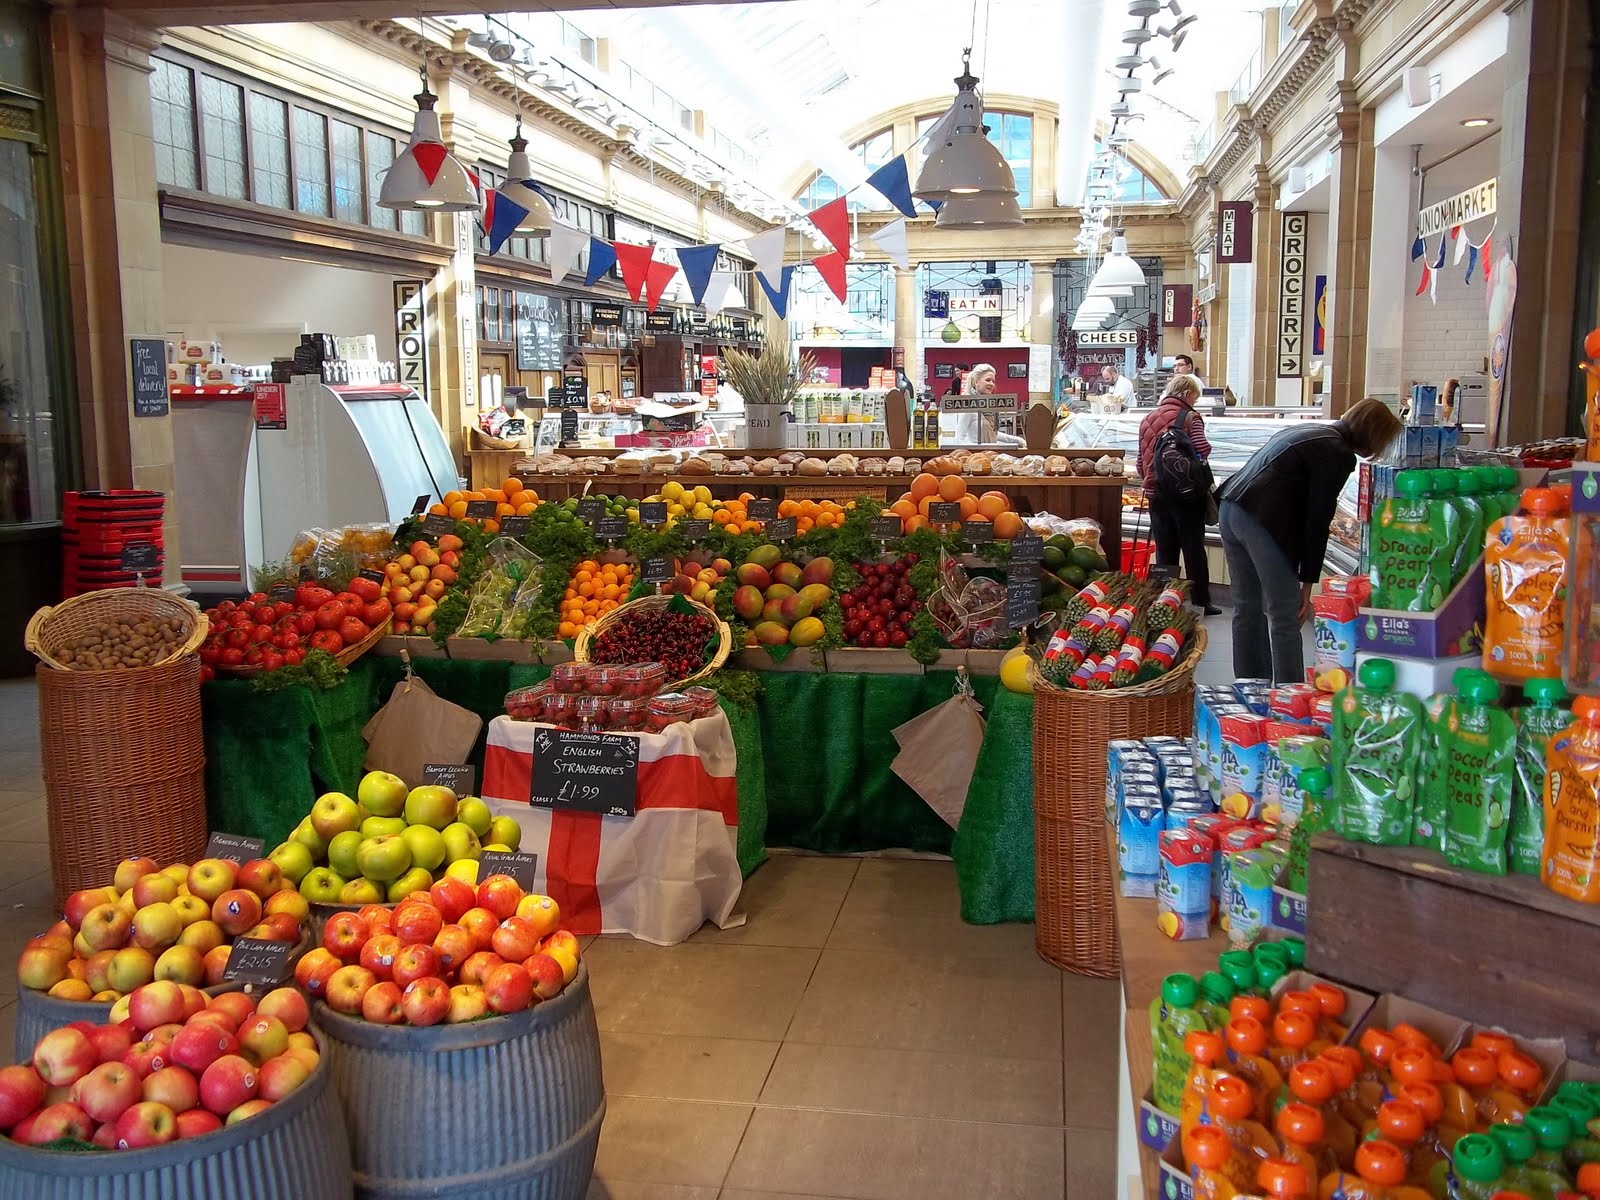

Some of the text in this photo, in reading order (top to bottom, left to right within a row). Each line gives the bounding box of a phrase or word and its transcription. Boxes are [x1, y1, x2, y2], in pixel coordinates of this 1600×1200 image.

[1419, 183, 1495, 236] UNION MARKET
[1224, 210, 1235, 255] MEAT
[1283, 217, 1303, 353] GROCERY
[950, 299, 997, 309] EAT IN
[1166, 290, 1174, 321] DELI
[401, 286, 421, 391] FROZ
[1080, 331, 1137, 343] CHEESE
[136, 341, 151, 366] free
[142, 360, 159, 376] local
[138, 376, 167, 398] delivery!
[945, 398, 1015, 409] SALAD BAR
[1517, 525, 1552, 536] Ella's
[1382, 618, 1410, 629] Ella's
[536, 731, 548, 743] TRY
[540, 739, 551, 749] ME
[560, 732, 622, 743] HAMMONDS FARM
[562, 746, 602, 757] ENGLISH
[552, 759, 625, 775] STRAWBERRIES
[1450, 748, 1497, 773] roccoli
[1448, 766, 1483, 786] pear
[557, 780, 600, 801] £1.99
[610, 806, 628, 815] 250g
[515, 855, 533, 863] APPLES
[266, 943, 286, 953] APPLES
[236, 953, 277, 969] £2.15
